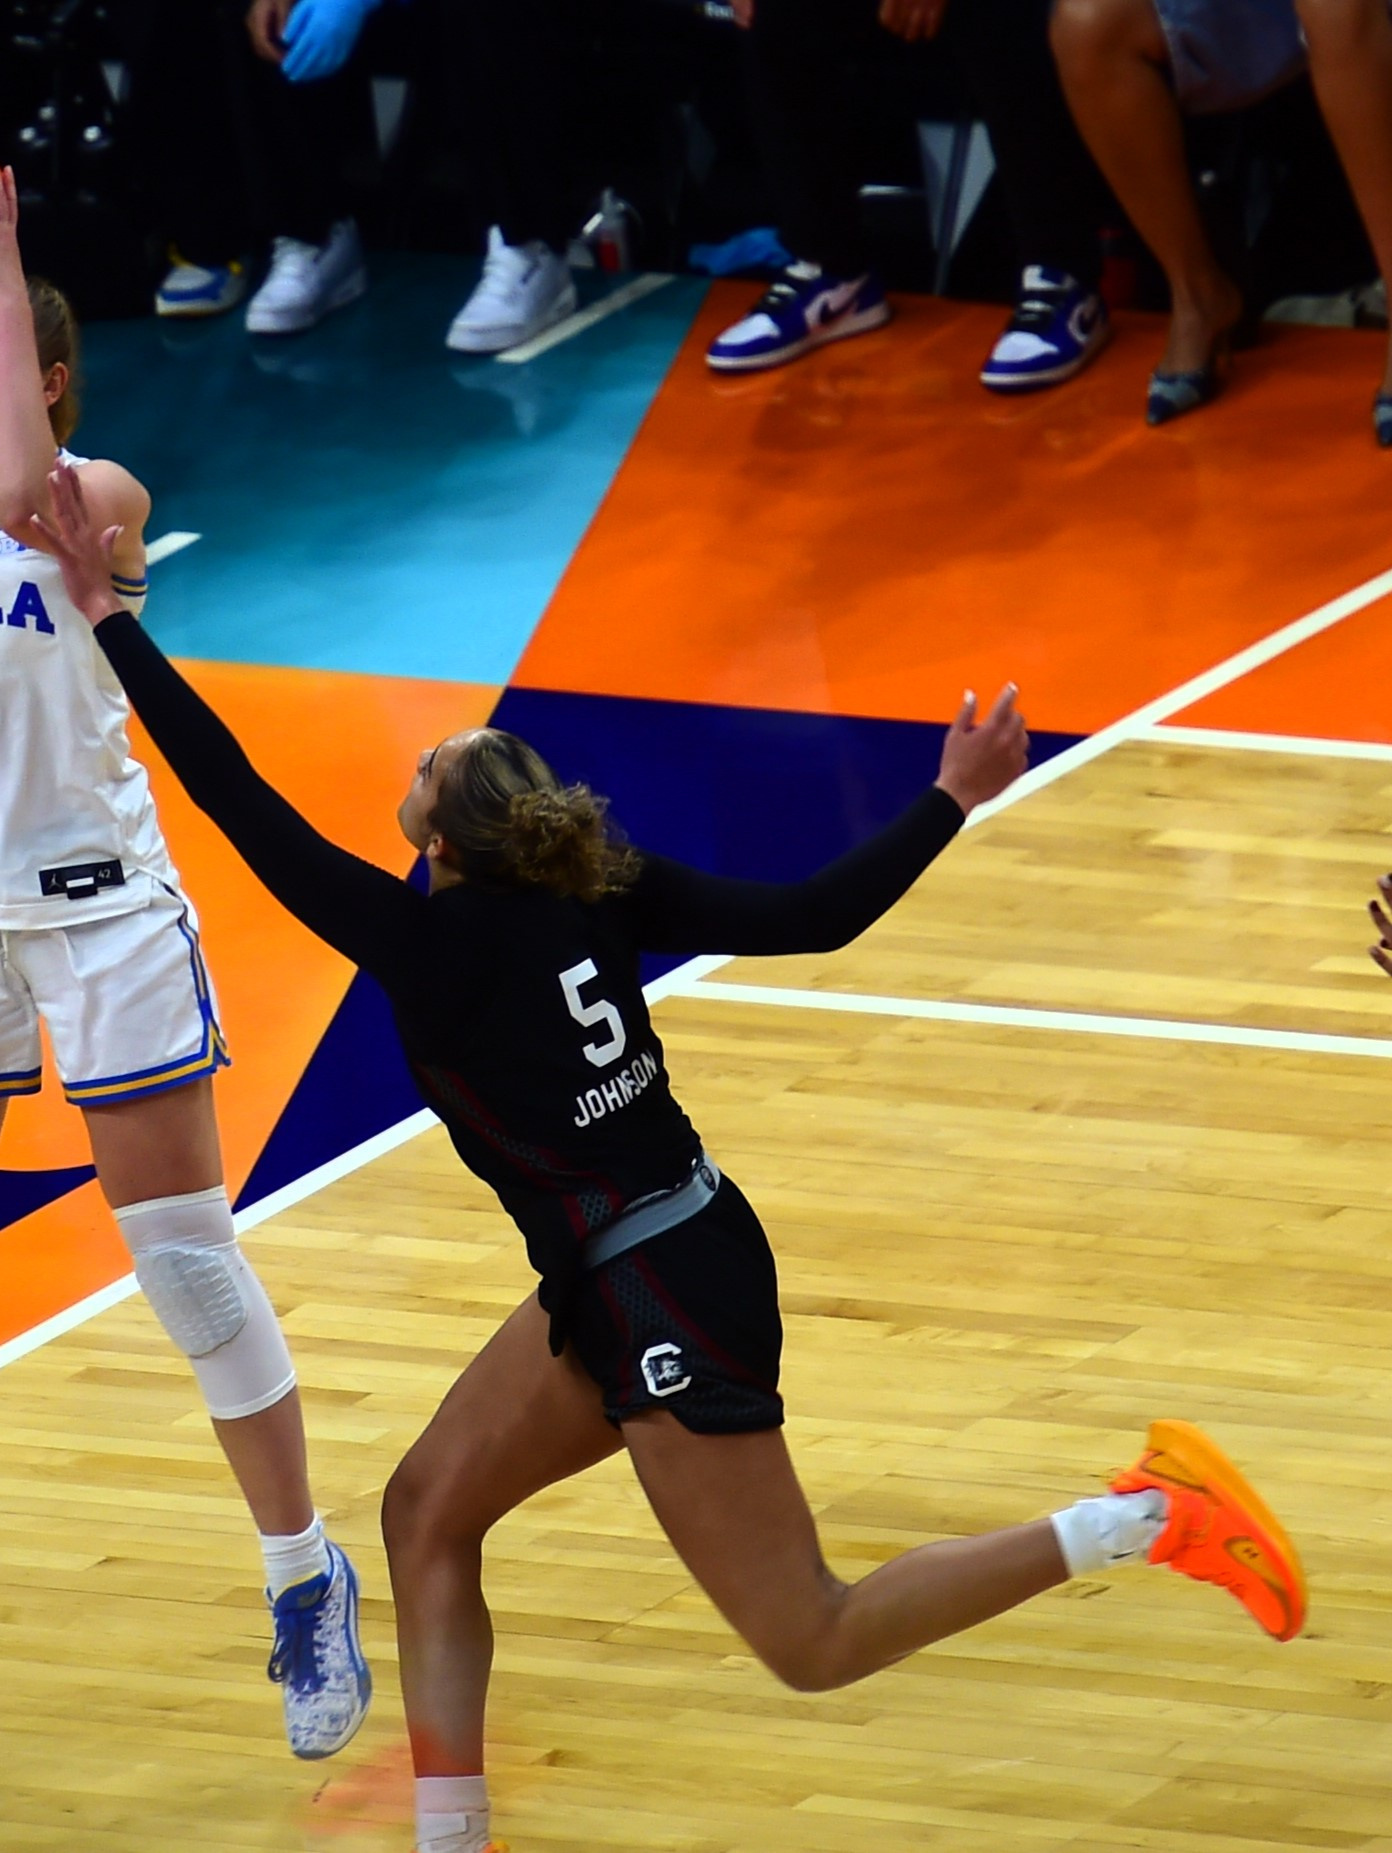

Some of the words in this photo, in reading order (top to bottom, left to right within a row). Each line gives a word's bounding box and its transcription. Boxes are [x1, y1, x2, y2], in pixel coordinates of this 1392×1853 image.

[98, 868, 112, 879] 42
[558, 957, 627, 1068] 5
[573, 1048, 658, 1128] JOHNSON
